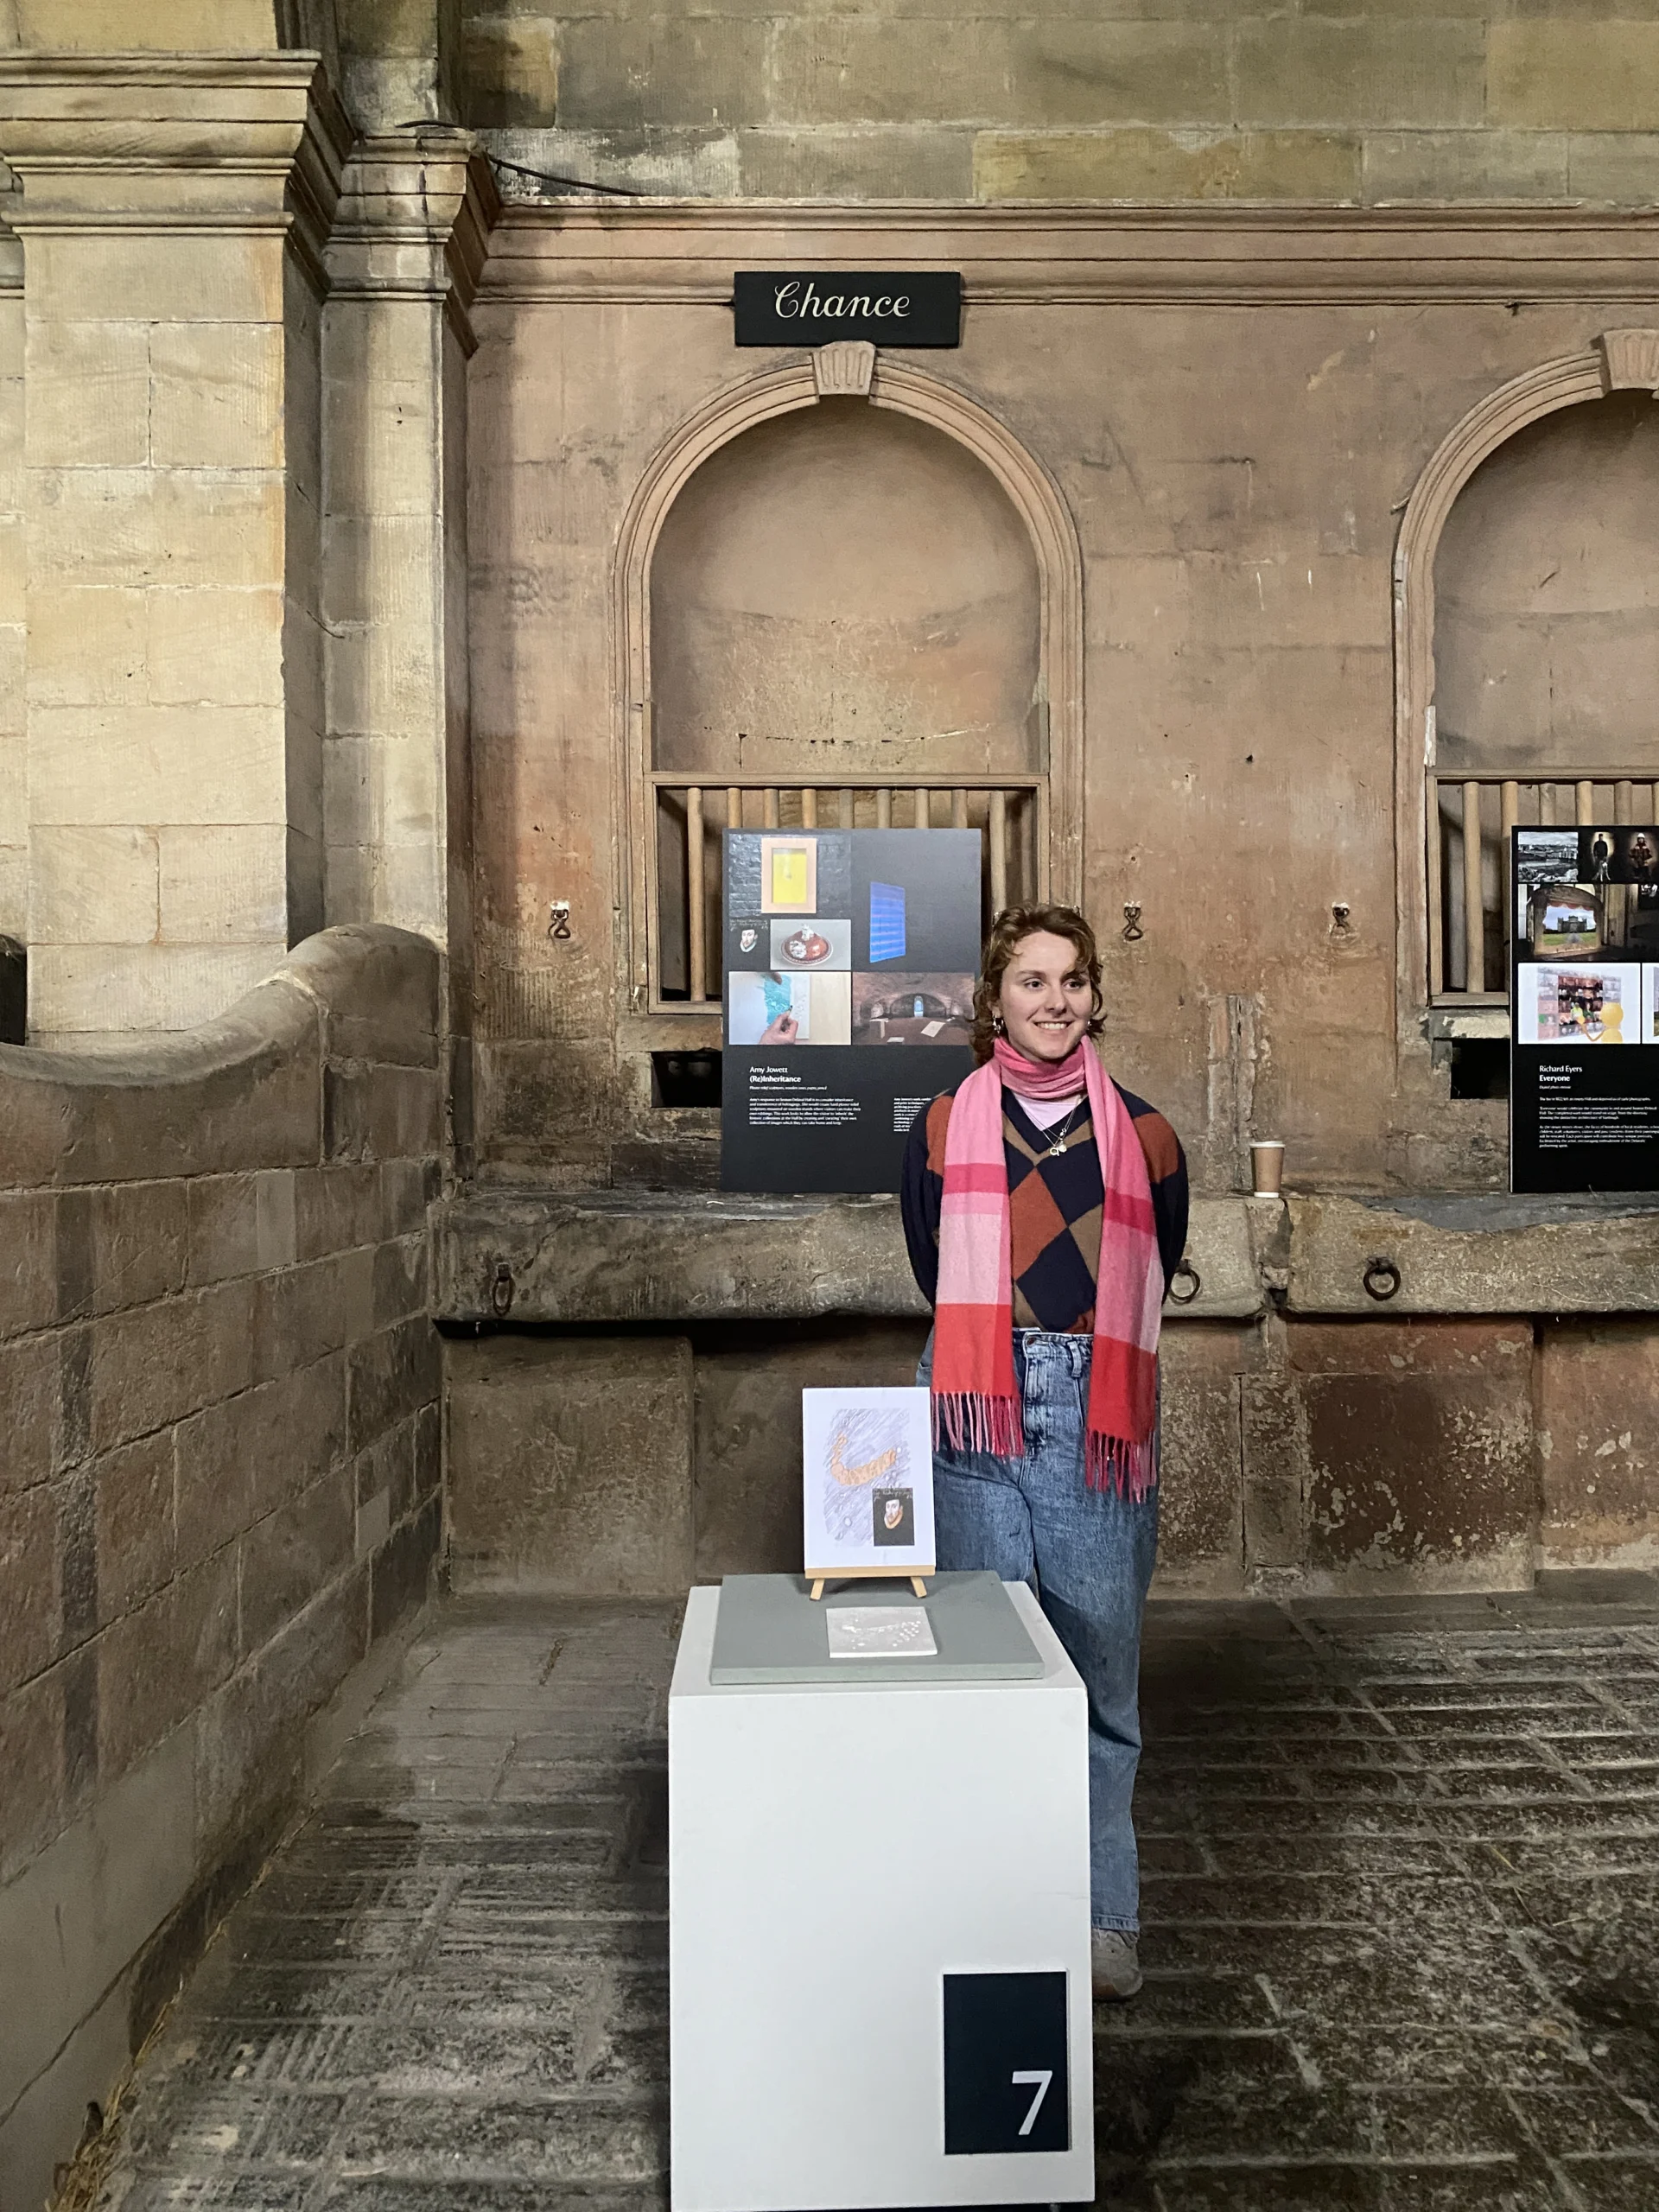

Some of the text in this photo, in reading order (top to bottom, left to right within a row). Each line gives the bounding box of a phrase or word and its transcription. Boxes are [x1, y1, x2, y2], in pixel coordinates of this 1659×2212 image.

[774, 281, 911, 318] Chance
[1539, 1074, 1571, 1083] Everyone
[1012, 2070, 1053, 2136] 7
